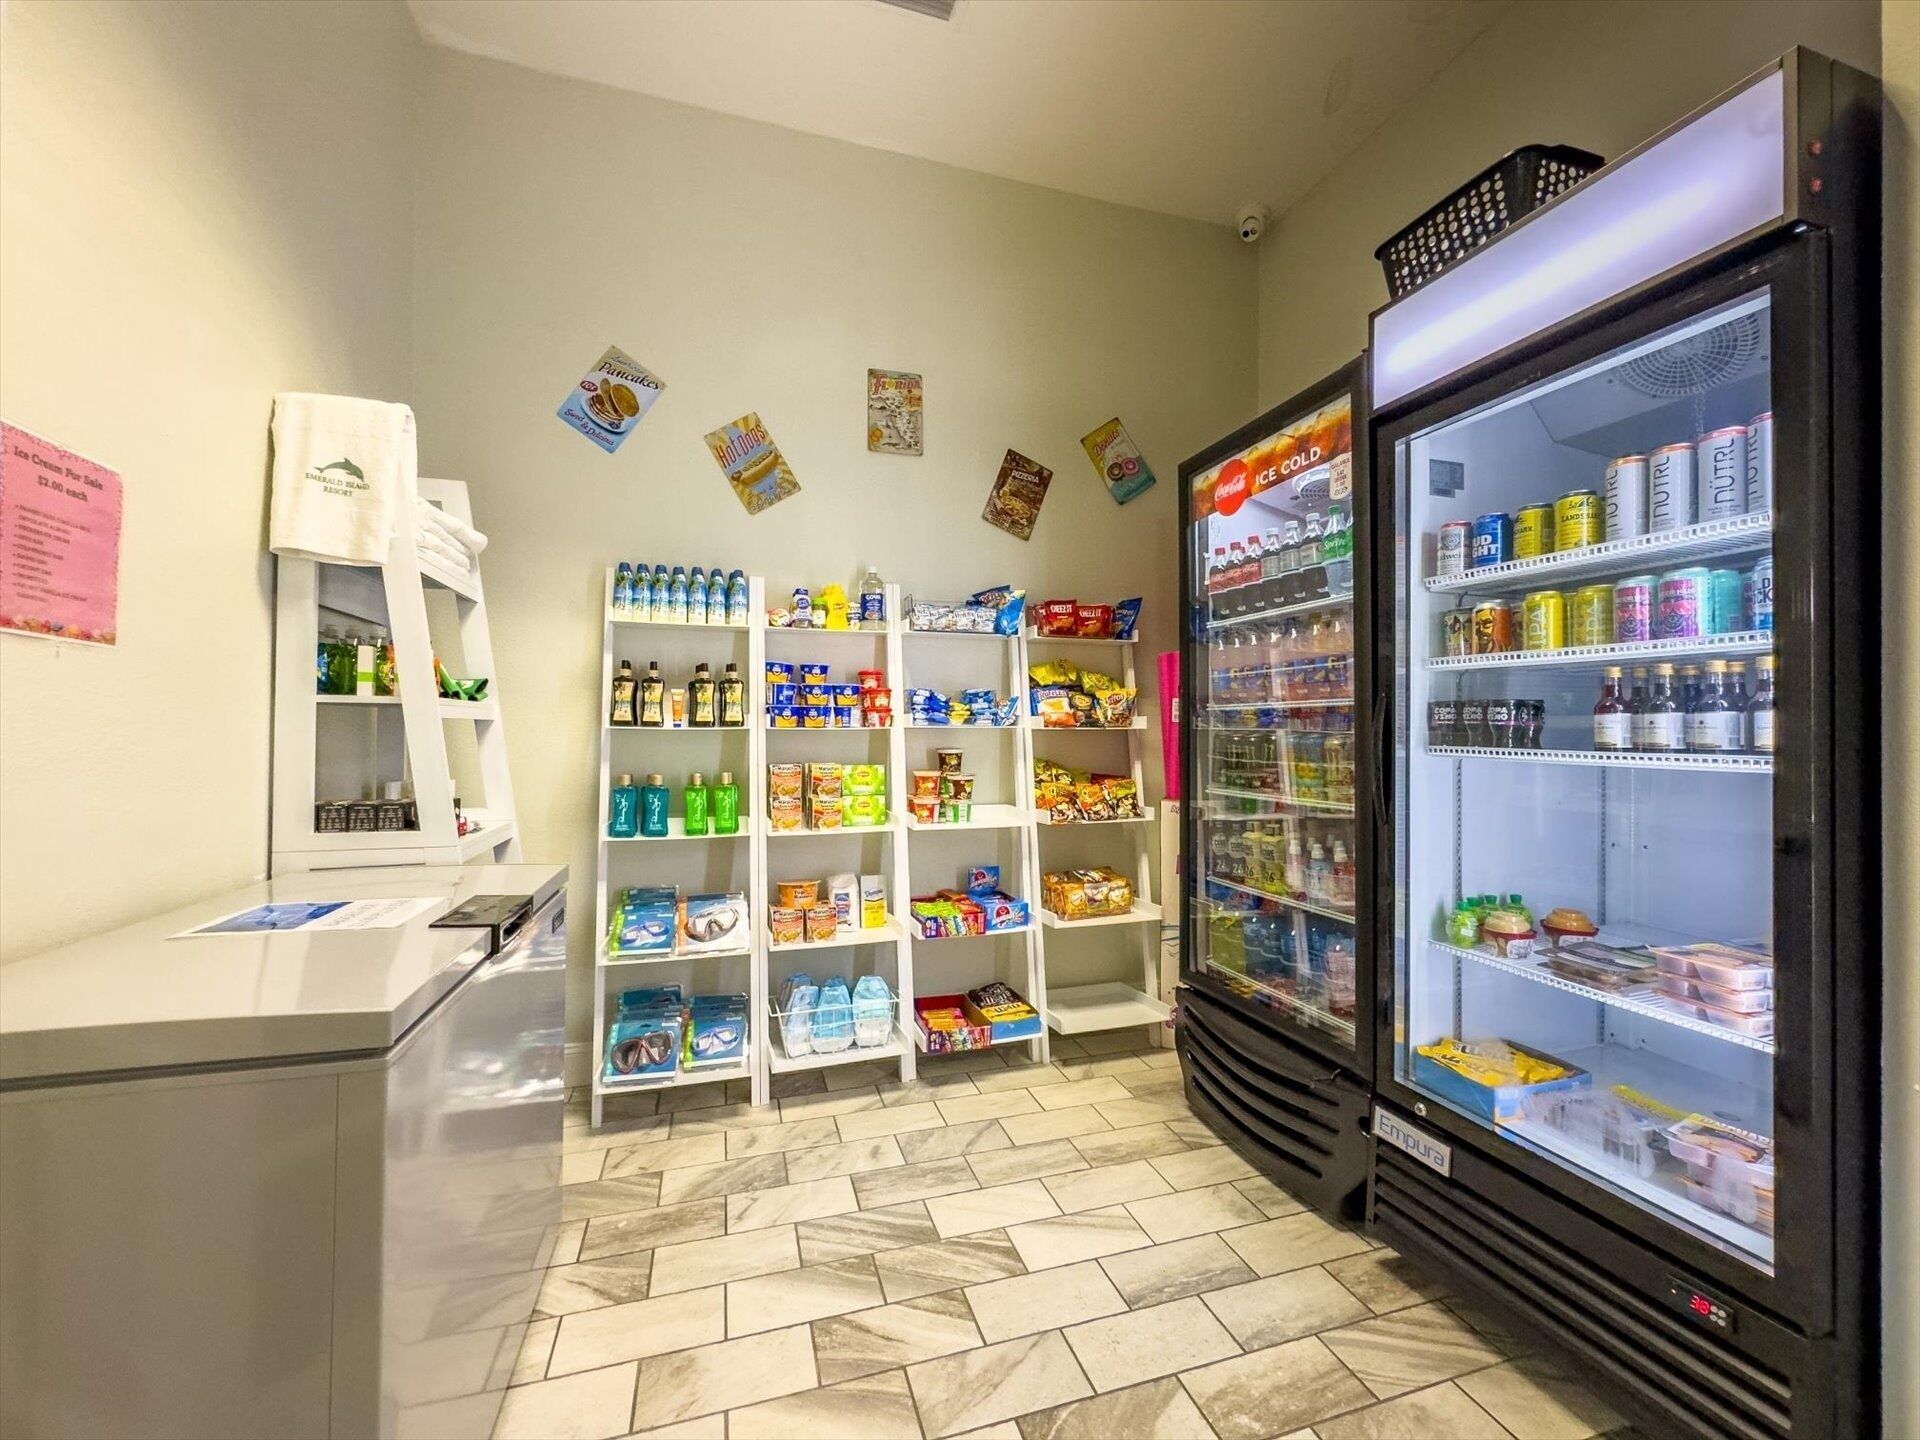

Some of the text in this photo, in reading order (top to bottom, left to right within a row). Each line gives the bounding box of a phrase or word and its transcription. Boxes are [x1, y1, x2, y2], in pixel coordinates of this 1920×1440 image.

[598, 361, 660, 390] Pancakes
[564, 408, 585, 422] Sweet
[586, 427, 615, 446] Delicious
[716, 423, 766, 469] Hot Dogs
[14, 446, 103, 491] Ice Cream For Sale
[305, 472, 370, 491] EMERALD ISLAND
[1011, 470, 1040, 483] PIZZERIA
[1255, 446, 1321, 487] ICE COLD
[66, 488, 88, 502] each
[323, 485, 352, 497] RESORT
[1380, 1114, 1444, 1167] Empura
